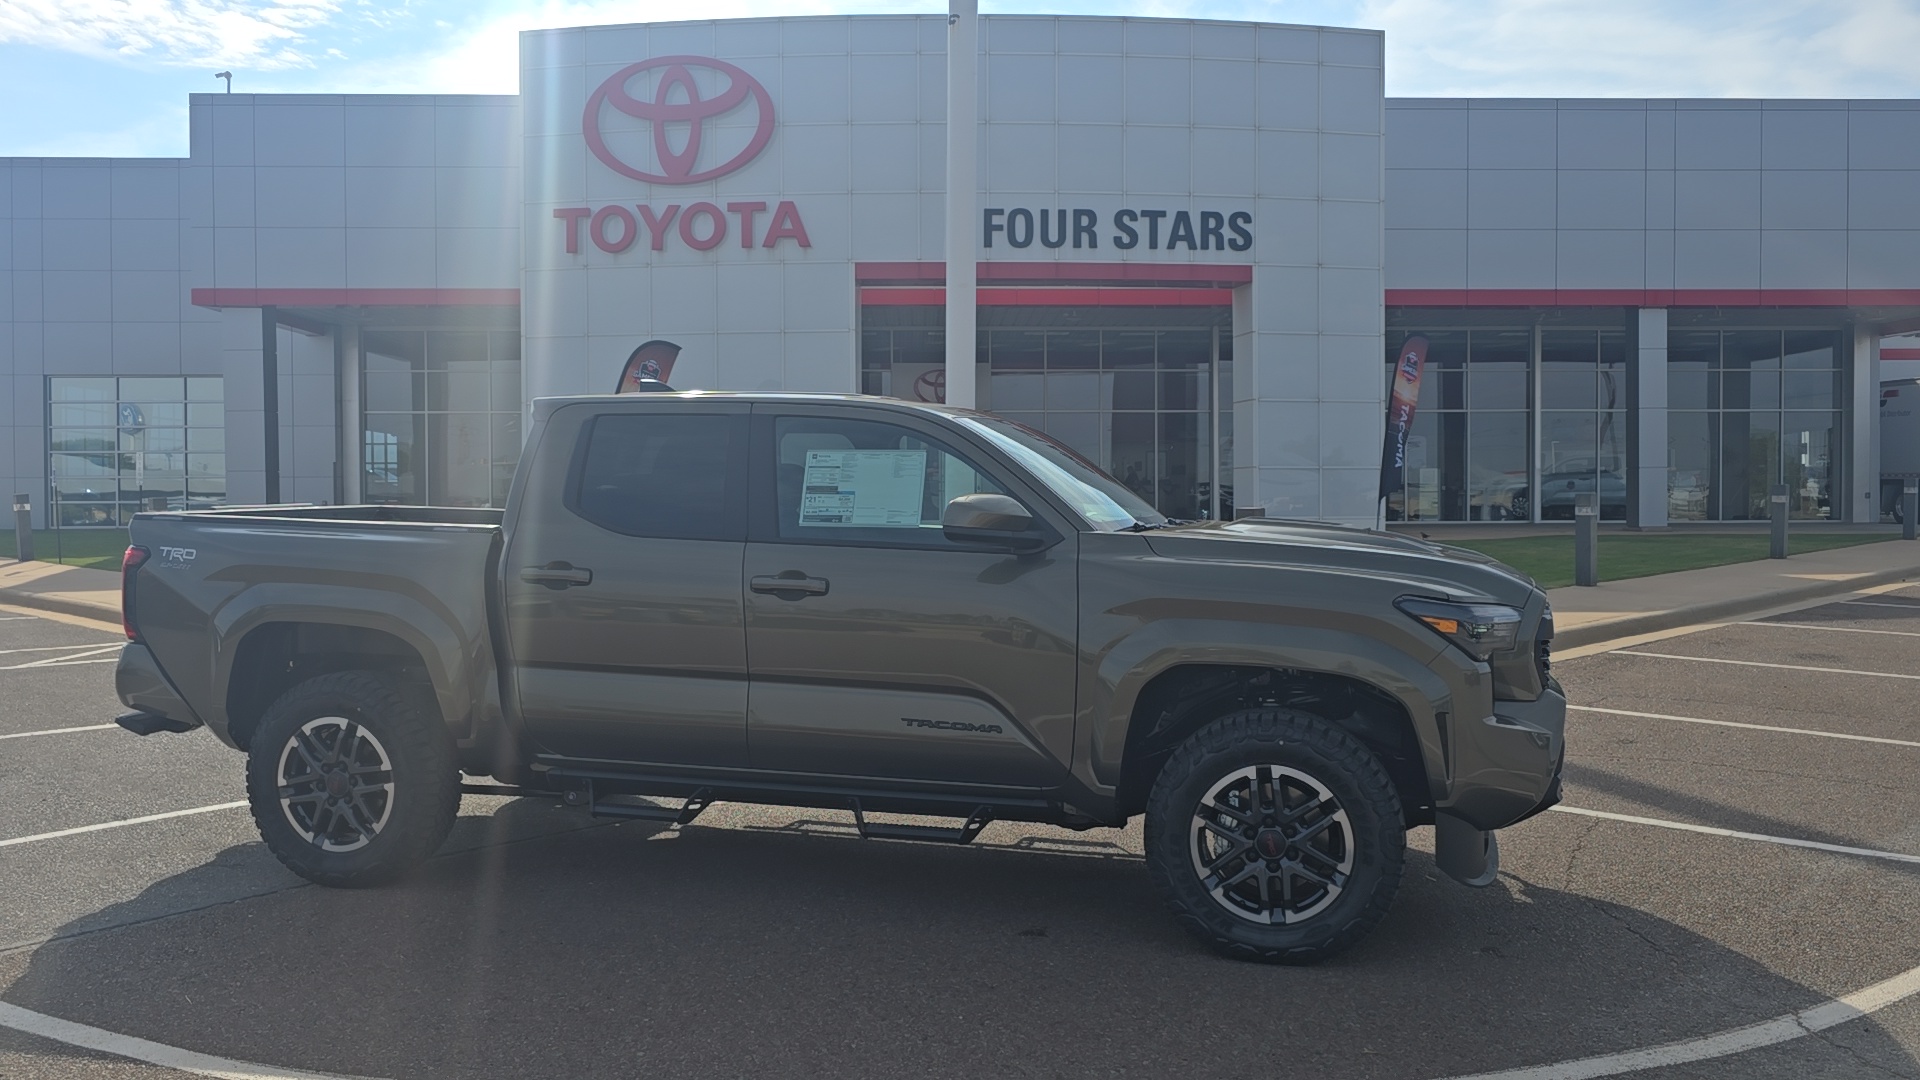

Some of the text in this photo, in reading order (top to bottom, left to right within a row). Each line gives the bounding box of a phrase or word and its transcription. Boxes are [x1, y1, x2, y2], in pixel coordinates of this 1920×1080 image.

[553, 200, 812, 254] TOYOTA
[983, 208, 1253, 251] FOUR STARS
[1394, 404, 1410, 468] TACOMA
[160, 546, 197, 562] TRD
[900, 717, 1003, 734] TACOMA
